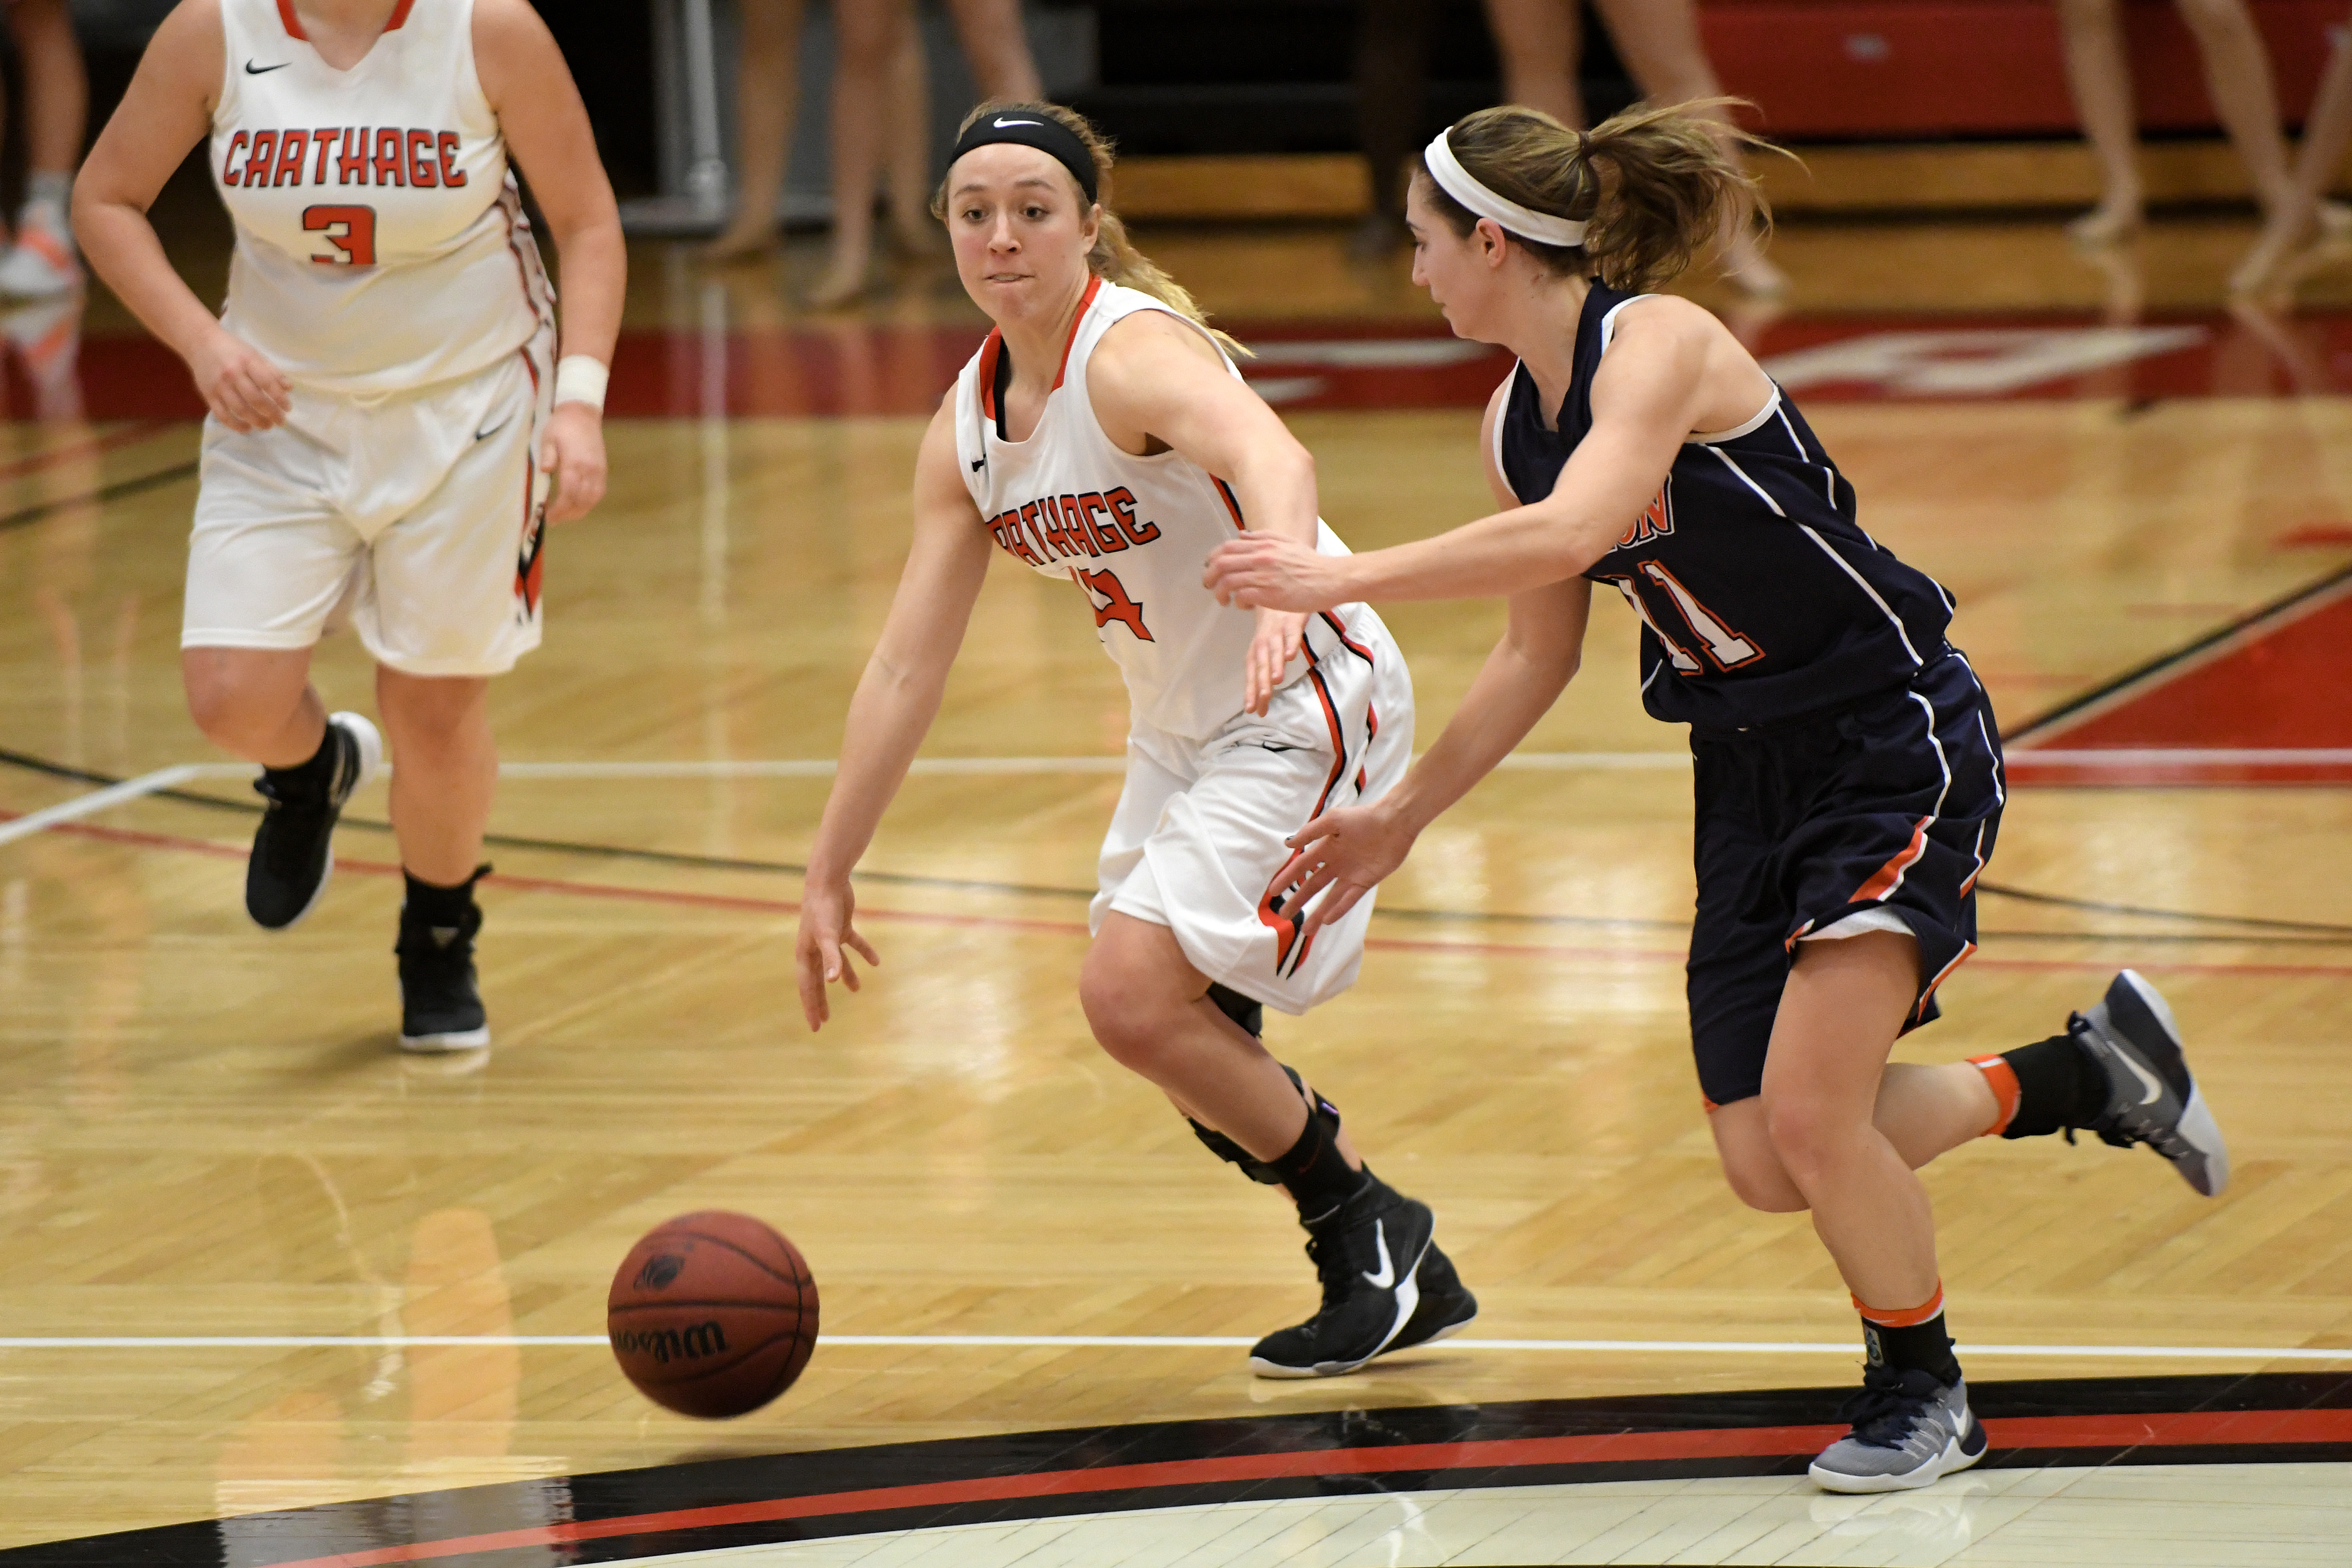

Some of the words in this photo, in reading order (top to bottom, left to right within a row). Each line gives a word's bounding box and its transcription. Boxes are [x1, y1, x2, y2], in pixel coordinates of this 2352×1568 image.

[224, 128, 467, 187] CARTHAGE
[302, 205, 376, 264] 3
[985, 487, 1162, 566] ARTHAGE
